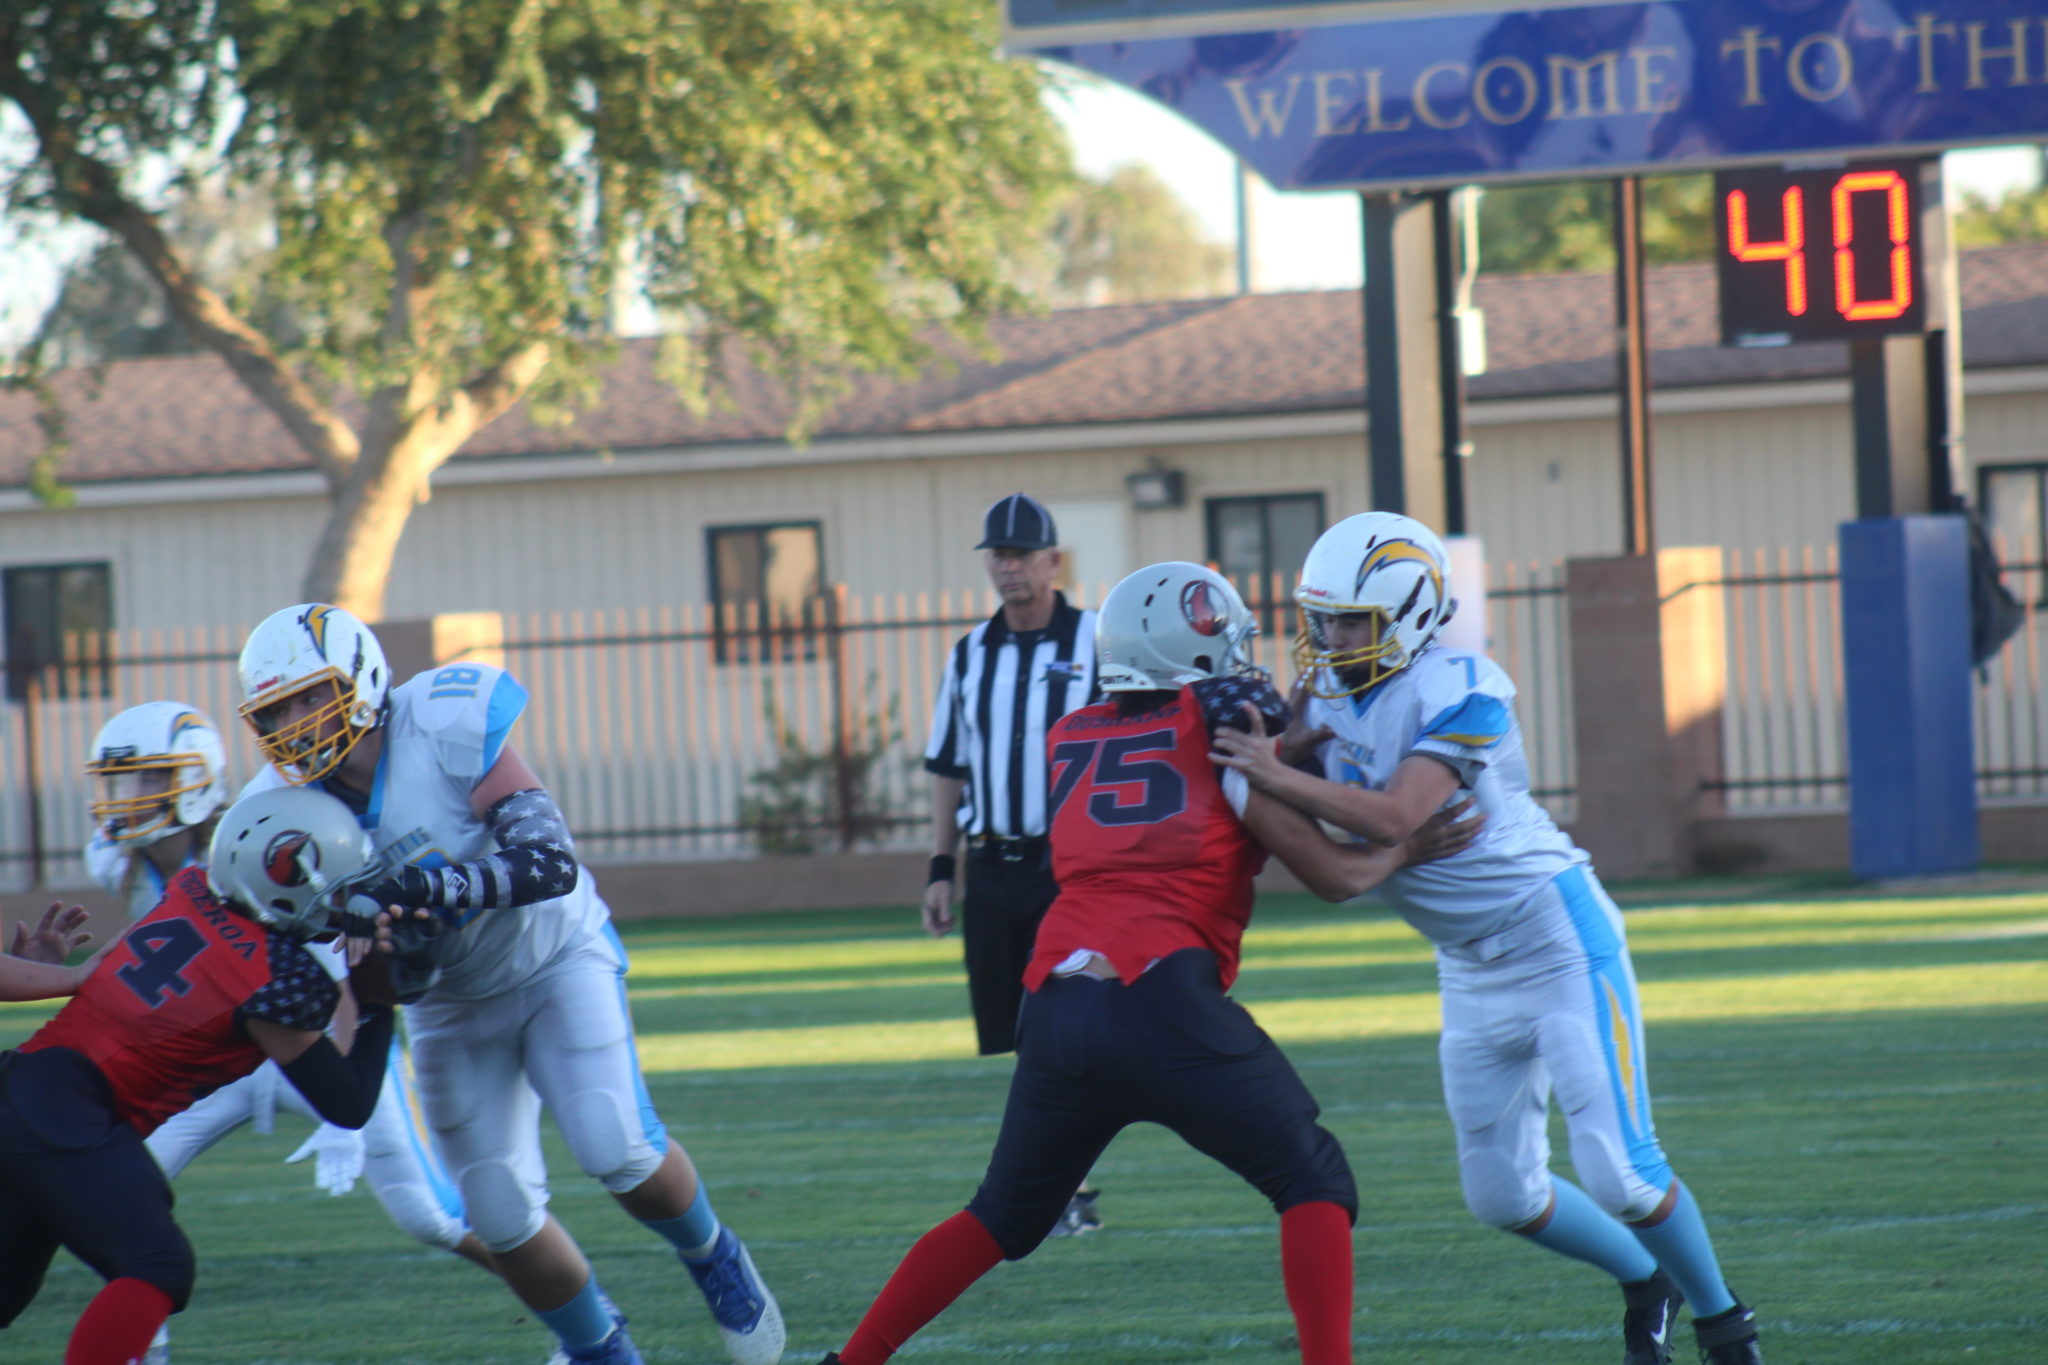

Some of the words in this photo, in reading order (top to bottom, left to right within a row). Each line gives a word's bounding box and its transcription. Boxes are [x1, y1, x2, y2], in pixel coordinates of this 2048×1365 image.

[1222, 46, 1682, 140] WELCOME
[1719, 25, 1853, 107] TO
[1891, 12, 2048, 94] TH
[1726, 169, 1913, 321] 40
[428, 667, 482, 701] 18
[1446, 655, 1478, 691] 7
[1048, 726, 1189, 834] 75
[114, 915, 212, 1010] 4
